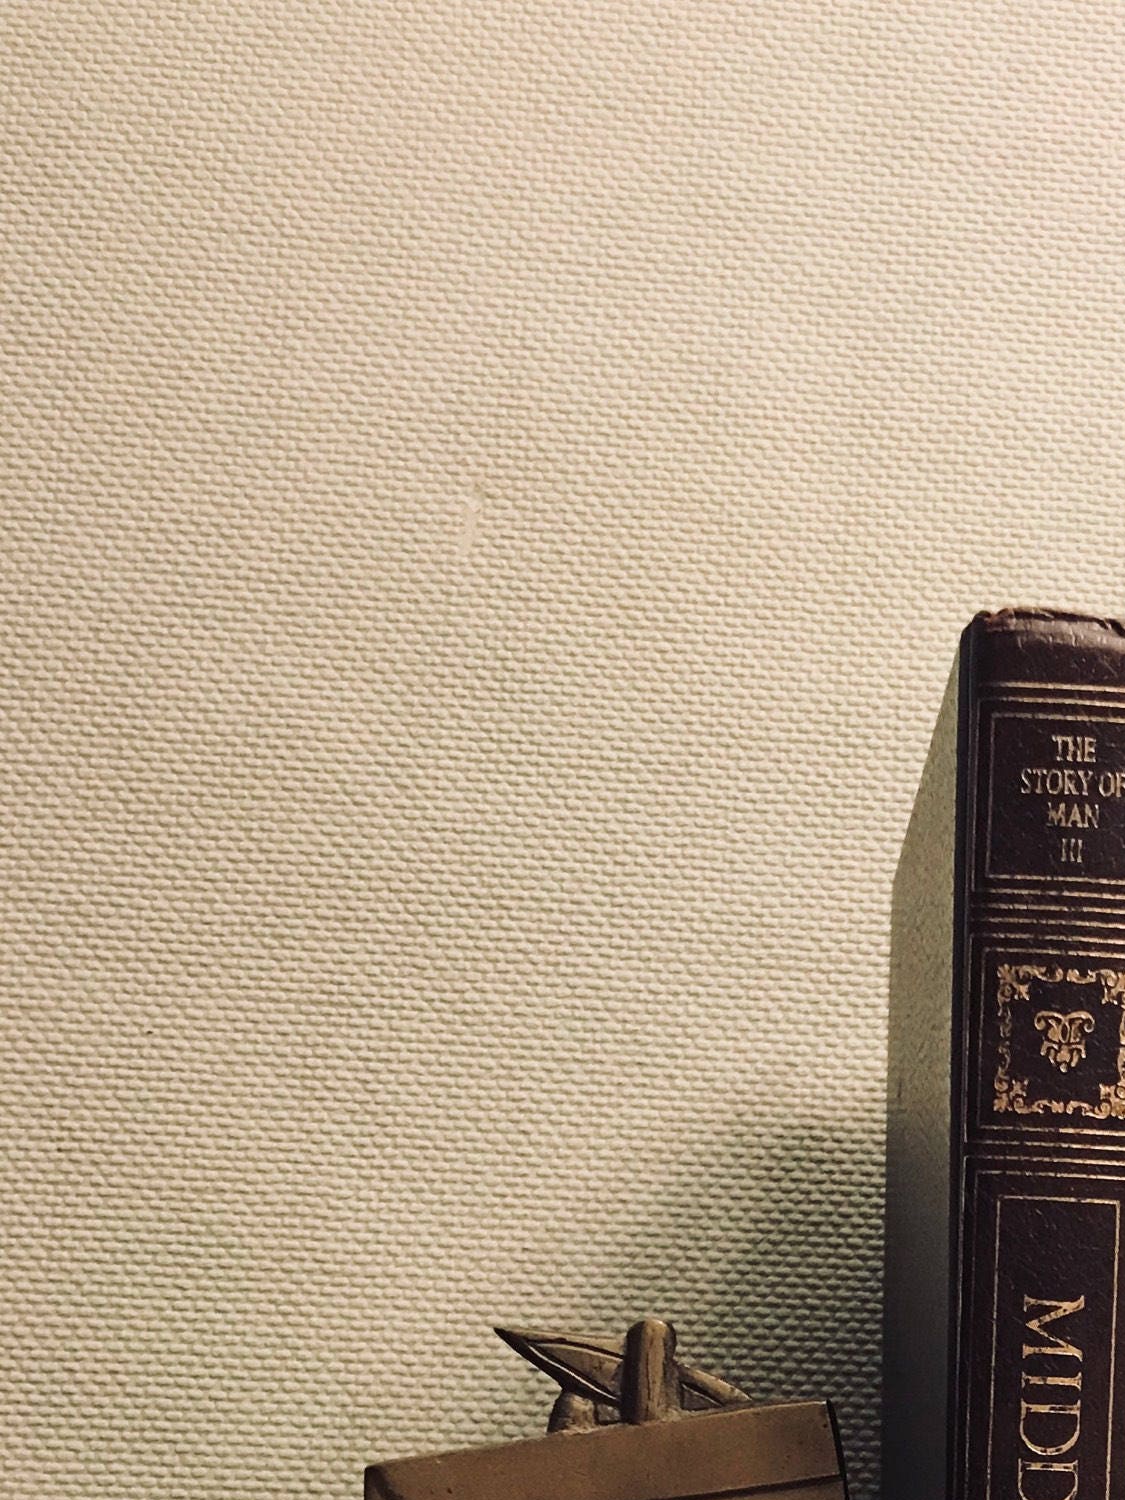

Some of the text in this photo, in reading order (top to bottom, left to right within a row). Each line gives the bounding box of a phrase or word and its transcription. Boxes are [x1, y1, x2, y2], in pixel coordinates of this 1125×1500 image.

[1052, 735, 1097, 763] THE
[1020, 768, 1094, 796] STORY
[1047, 802, 1100, 829] MAN
[1060, 838, 1084, 863] III
